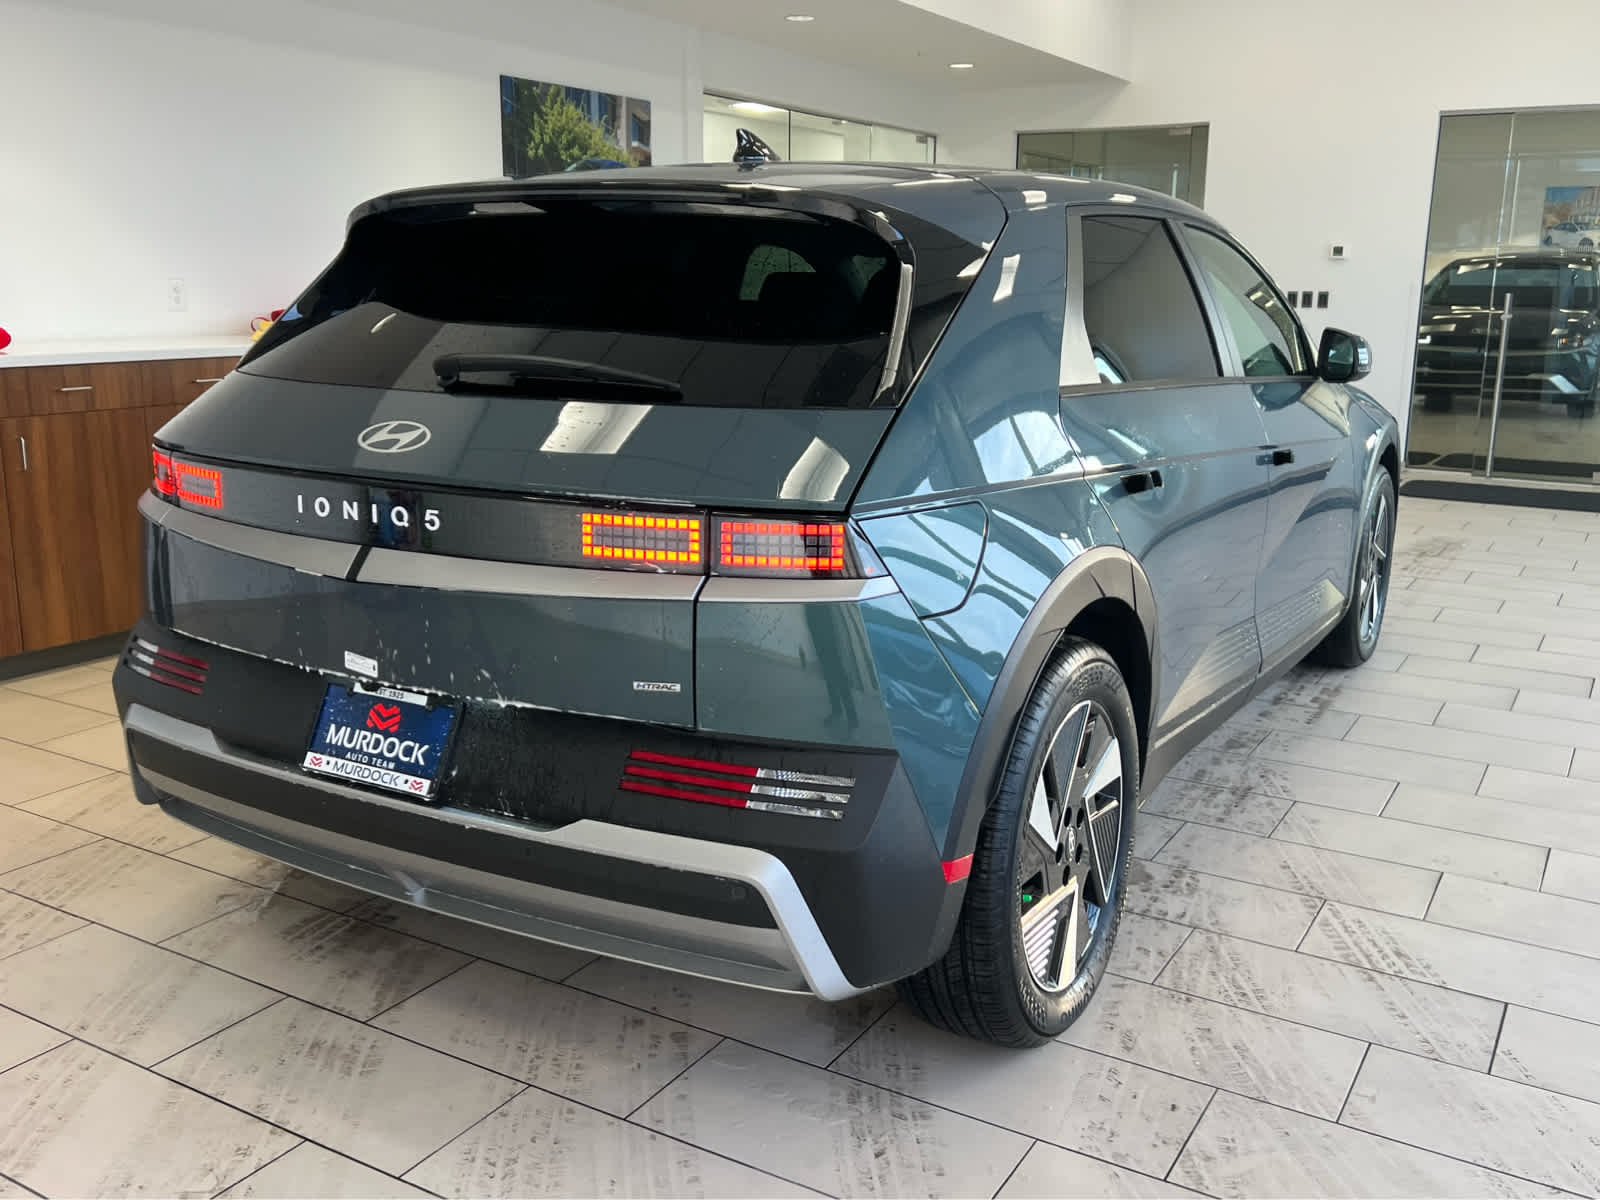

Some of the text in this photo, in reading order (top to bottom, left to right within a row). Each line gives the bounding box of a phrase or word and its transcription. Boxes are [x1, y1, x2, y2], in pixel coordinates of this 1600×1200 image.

[297, 494, 441, 532] IONIQ 5
[636, 682, 680, 691] HTRAC
[326, 723, 429, 765] MURDOCK
[345, 751, 396, 770] AUTO TEAM
[332, 761, 401, 787] MURDOCK
